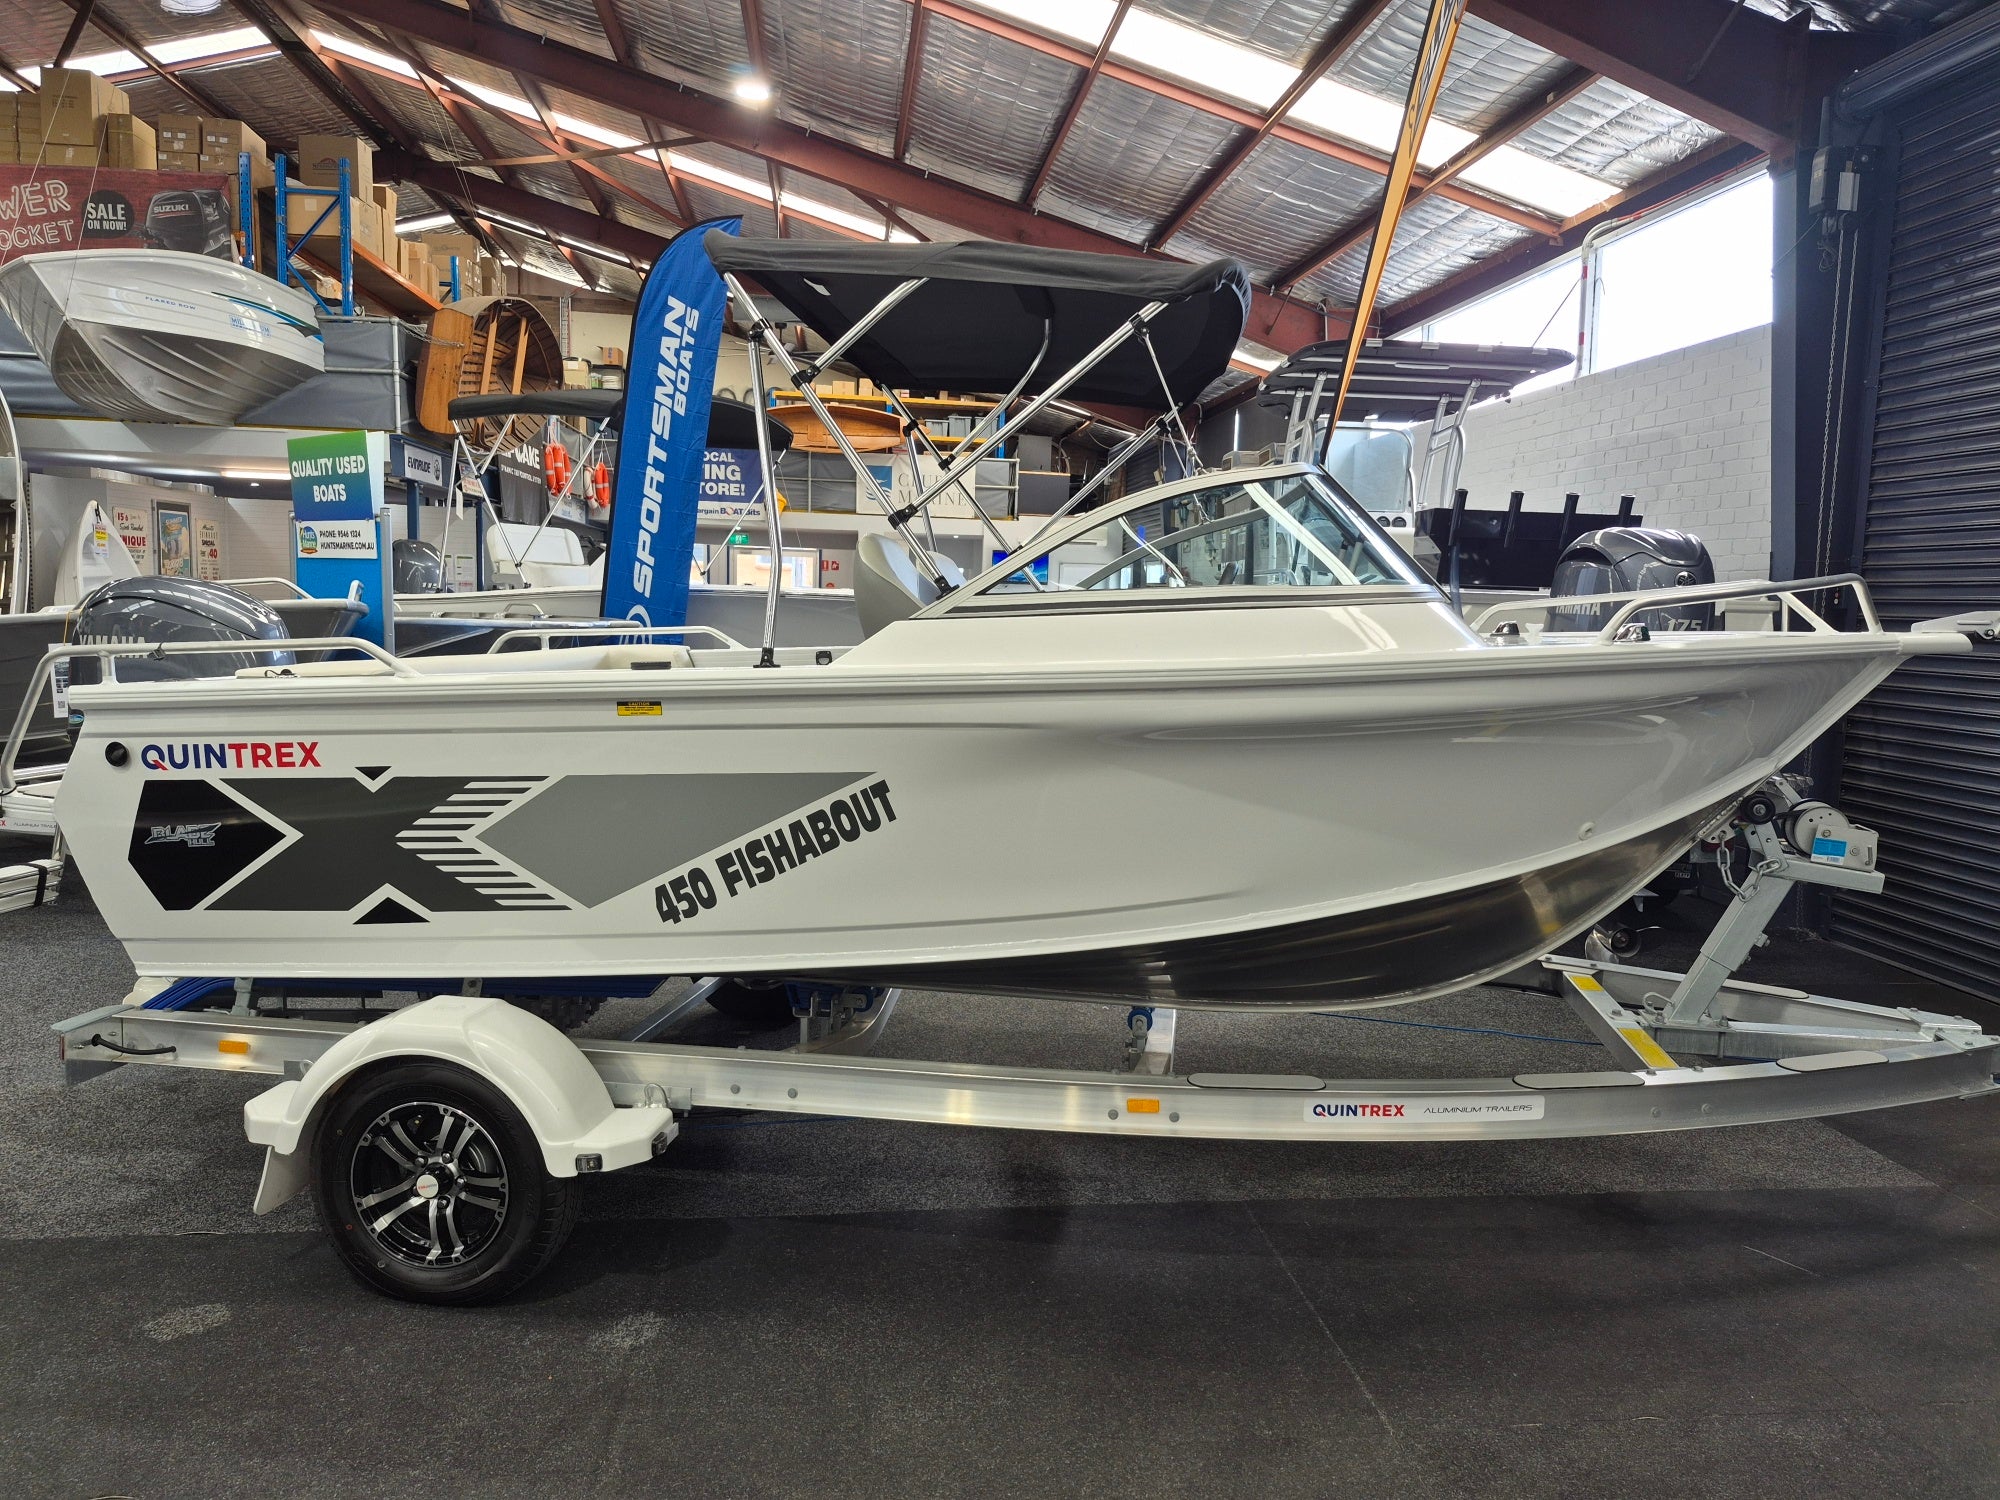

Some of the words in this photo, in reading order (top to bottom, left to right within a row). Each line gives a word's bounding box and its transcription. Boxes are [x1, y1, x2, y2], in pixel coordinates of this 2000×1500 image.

[87, 203, 125, 220] SALE
[153, 204, 189, 214] SUZUKI
[88, 220, 100, 229] ON
[103, 221, 127, 231] NOW!
[145, 296, 176, 306] FLARED
[673, 306, 699, 417] BOATS
[633, 295, 687, 599] SPORTSMAN
[408, 456, 431, 473] EVINRUDE
[703, 451, 735, 463] OCAL
[291, 457, 333, 478] QUALITY
[336, 455, 365, 475] USED
[703, 463, 741, 481] ING
[313, 483, 347, 503] BOATS
[700, 482, 745, 496] TORE!
[898, 489, 967, 506] MINE
[120, 534, 146, 546] NIQUE
[338, 530, 349, 538] 9546
[320, 542, 374, 550] HUNTSMARINE.COM.AU
[141, 741, 322, 771] QUINTREX
[147, 823, 219, 843] BLADE
[188, 838, 215, 847] HULL
[654, 867, 718, 924] 450
[715, 779, 897, 898] FISHABOUT
[1312, 1103, 1405, 1117] QUINTREX
[1424, 1105, 1482, 1114] ALUMINIUM
[1485, 1104, 1533, 1113] TRAILERS
